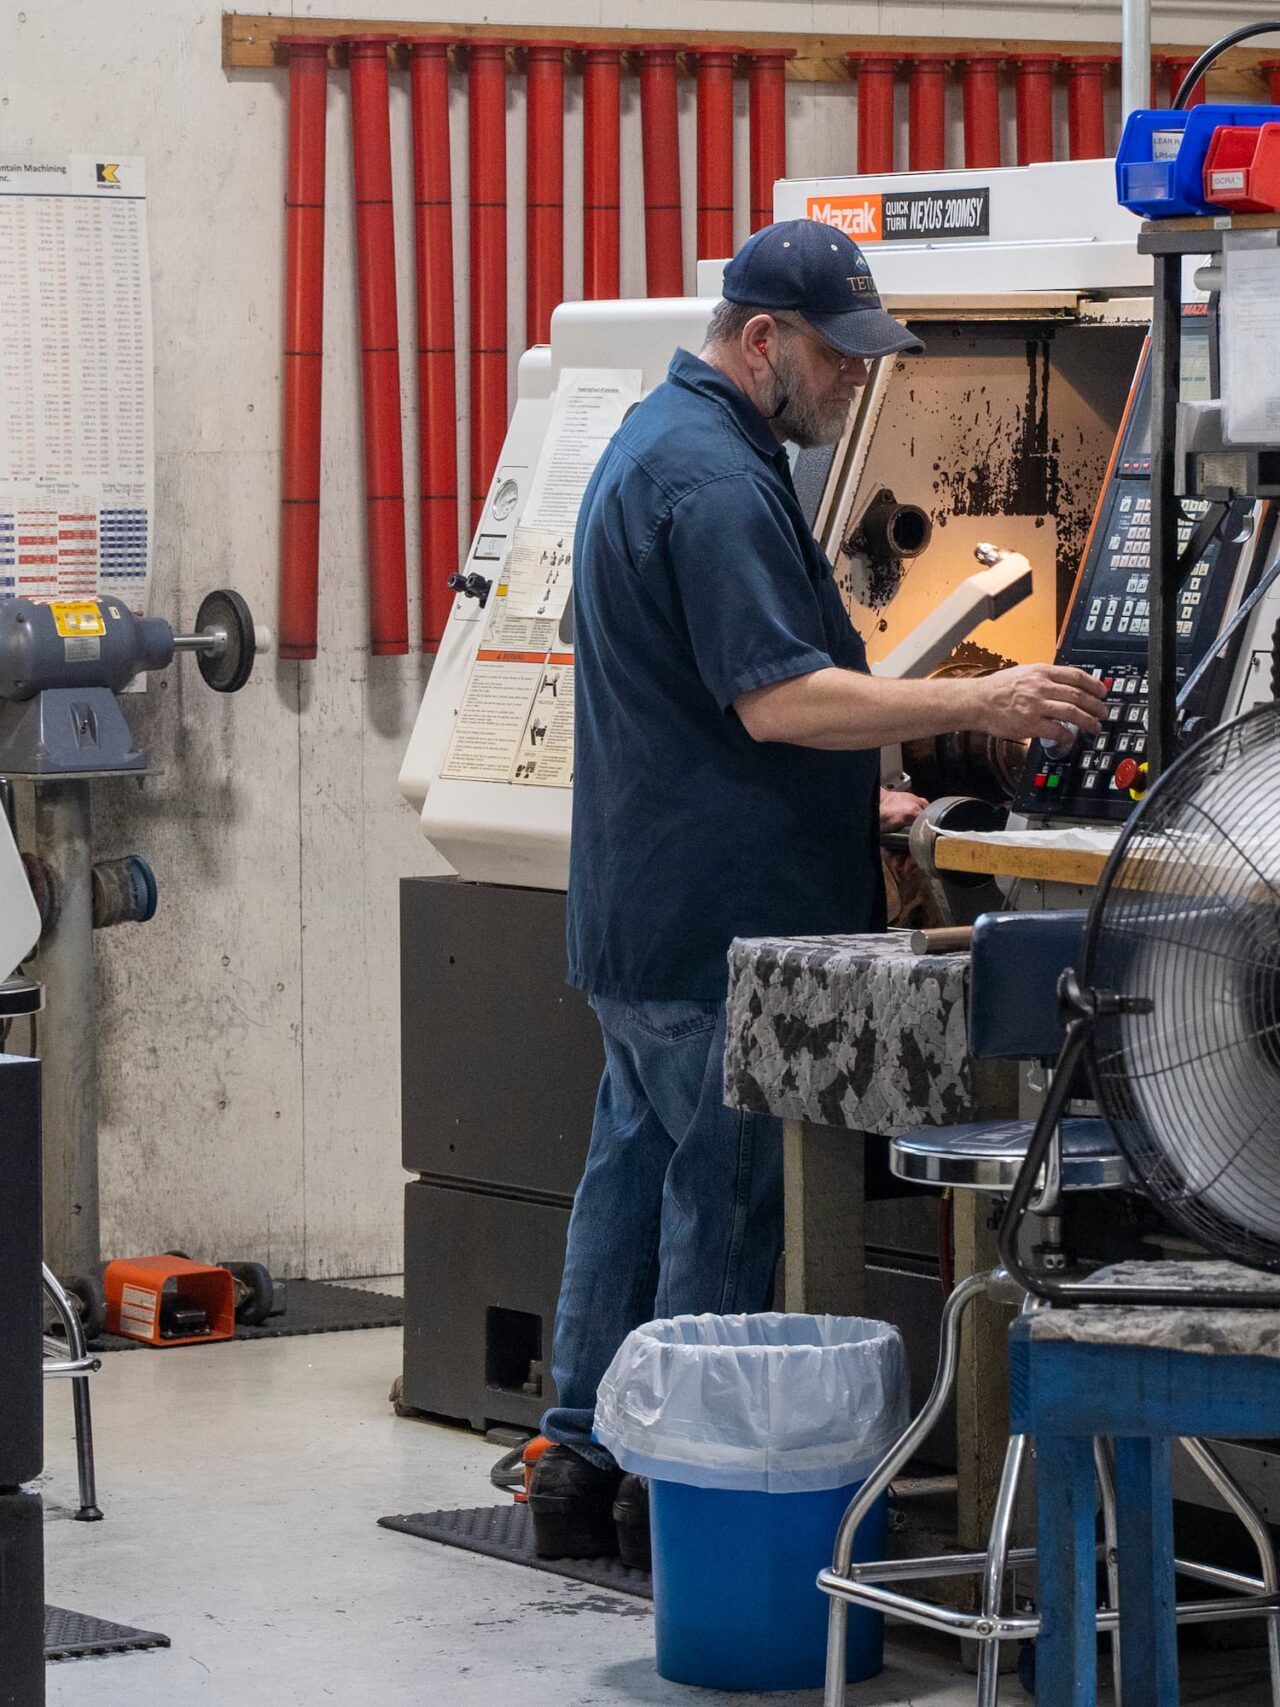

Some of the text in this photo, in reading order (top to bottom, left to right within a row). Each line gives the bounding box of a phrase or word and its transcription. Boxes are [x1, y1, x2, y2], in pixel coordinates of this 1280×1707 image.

[0, 164, 67, 175] ntain Machining
[0, 174, 11, 182] nc.
[885, 201, 909, 216] QUICK
[909, 197, 984, 233] NEXUS 200MSY
[812, 201, 877, 234] Mazak
[886, 216, 908, 231] TURN
[1183, 303, 1208, 315] MAZA
